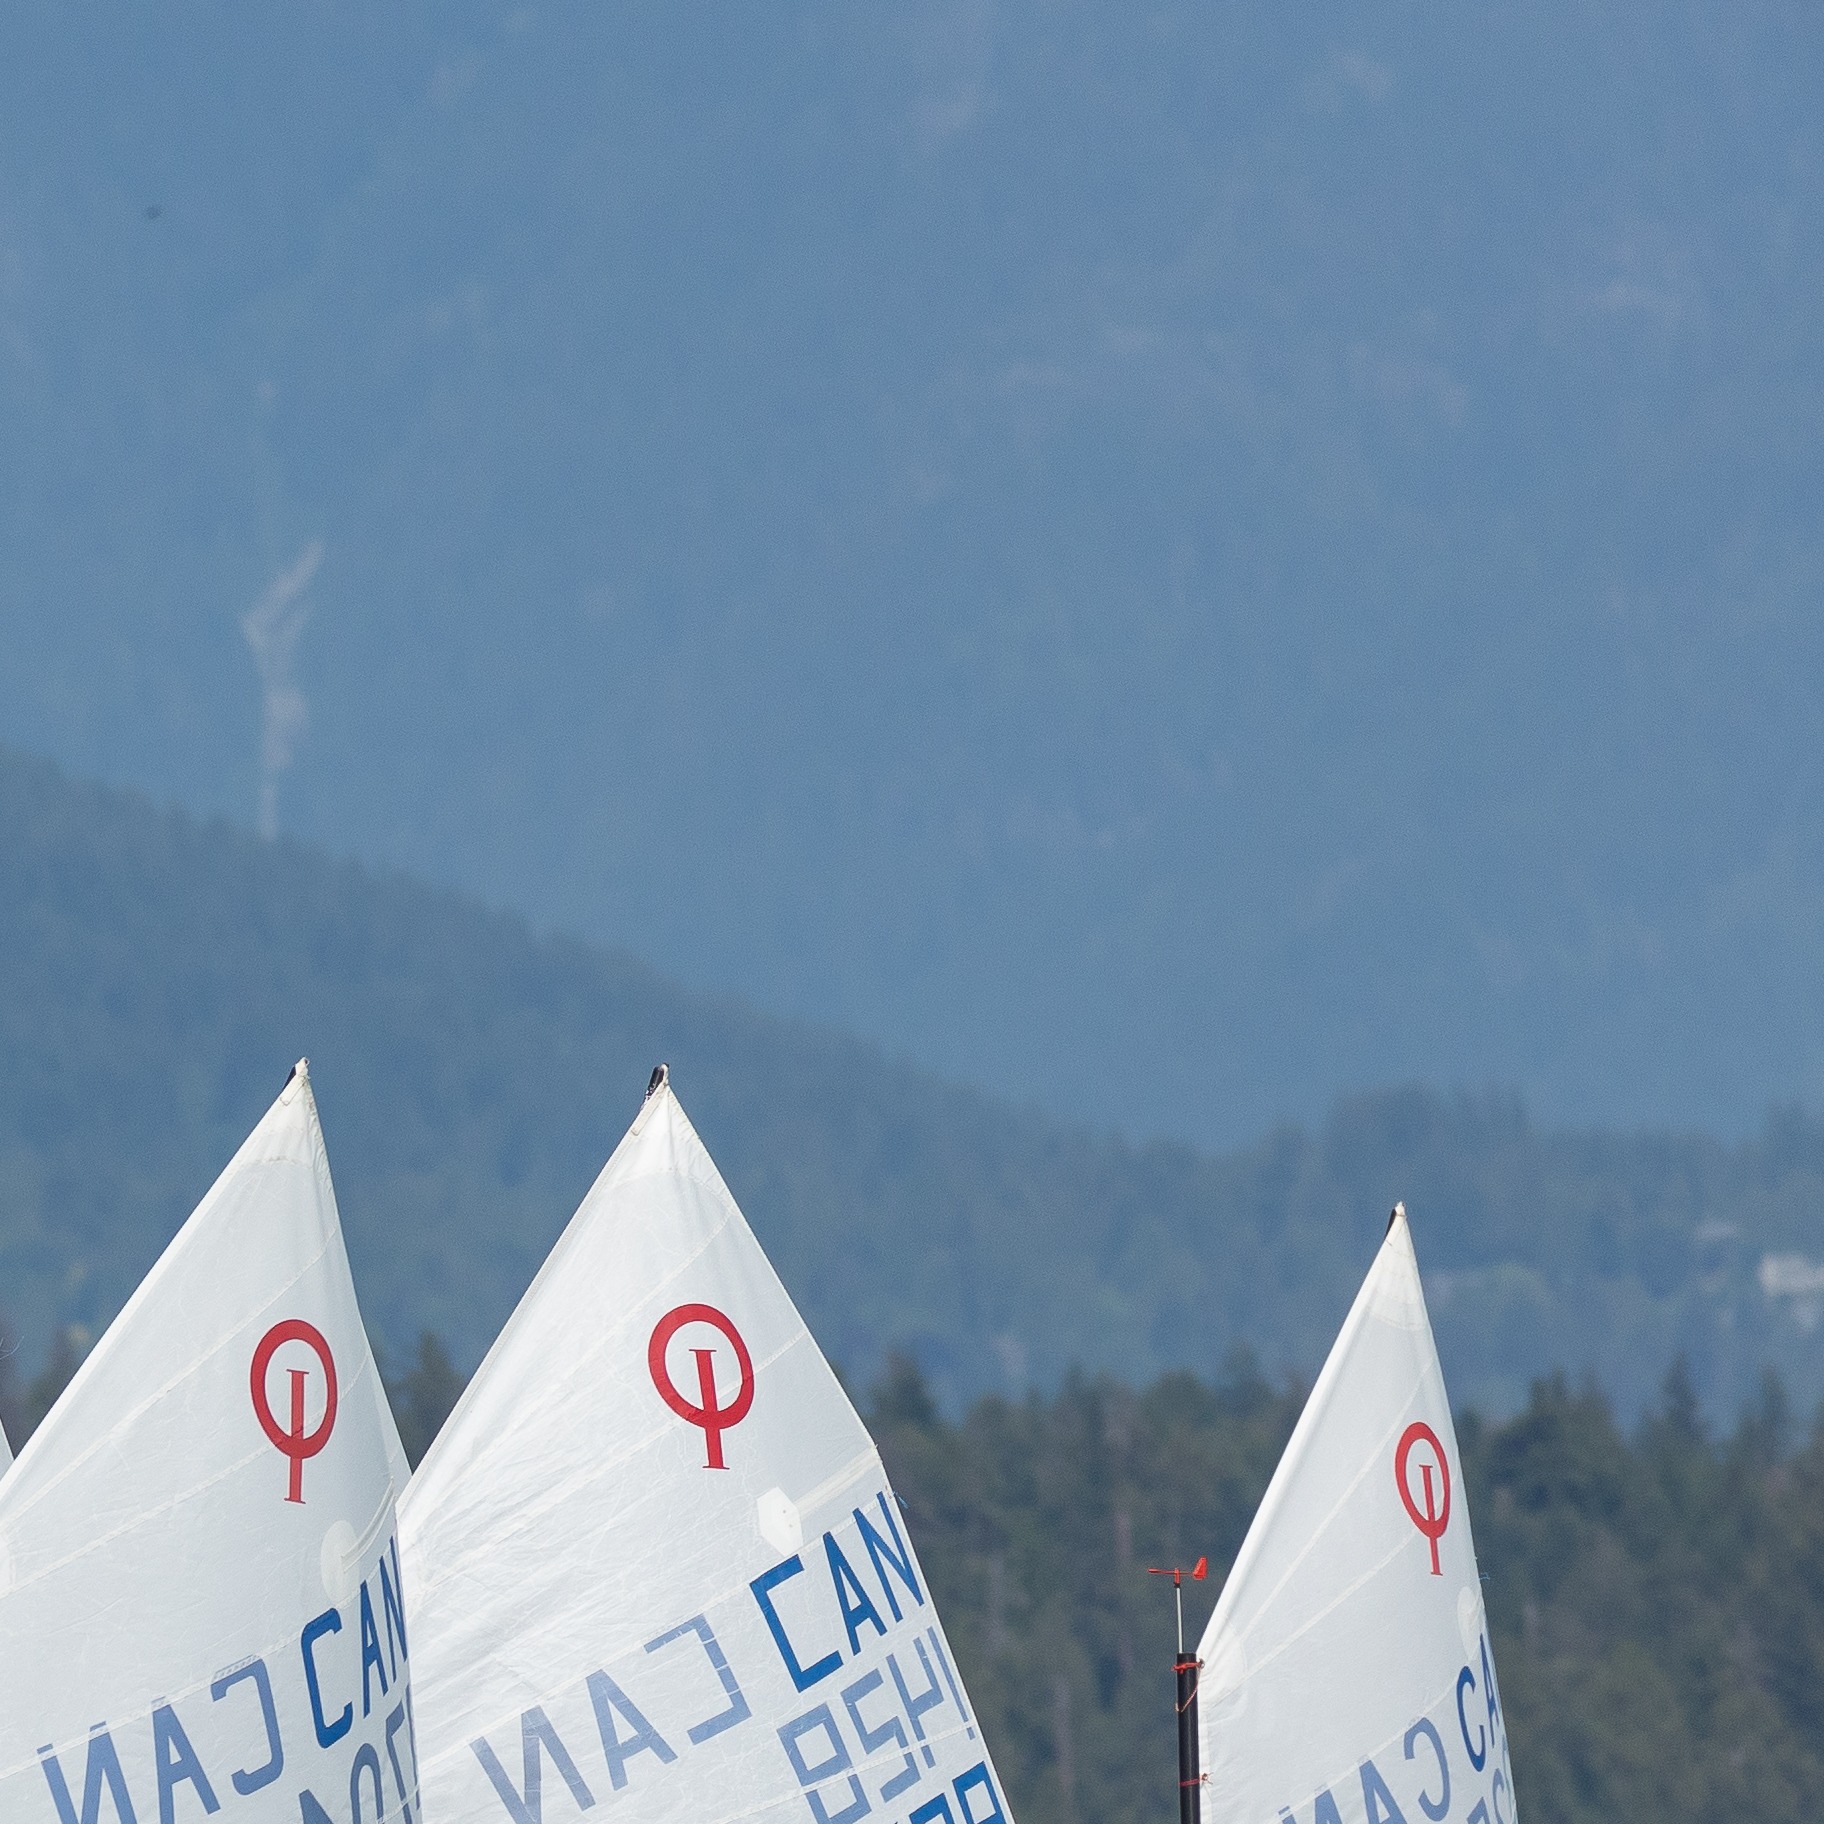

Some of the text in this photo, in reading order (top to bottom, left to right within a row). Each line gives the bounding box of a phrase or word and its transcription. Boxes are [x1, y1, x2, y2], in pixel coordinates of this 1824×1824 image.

[300, 1535, 408, 1749] CAN
[748, 1491, 925, 1693] CAN
[1456, 1632, 1500, 1772] CA
